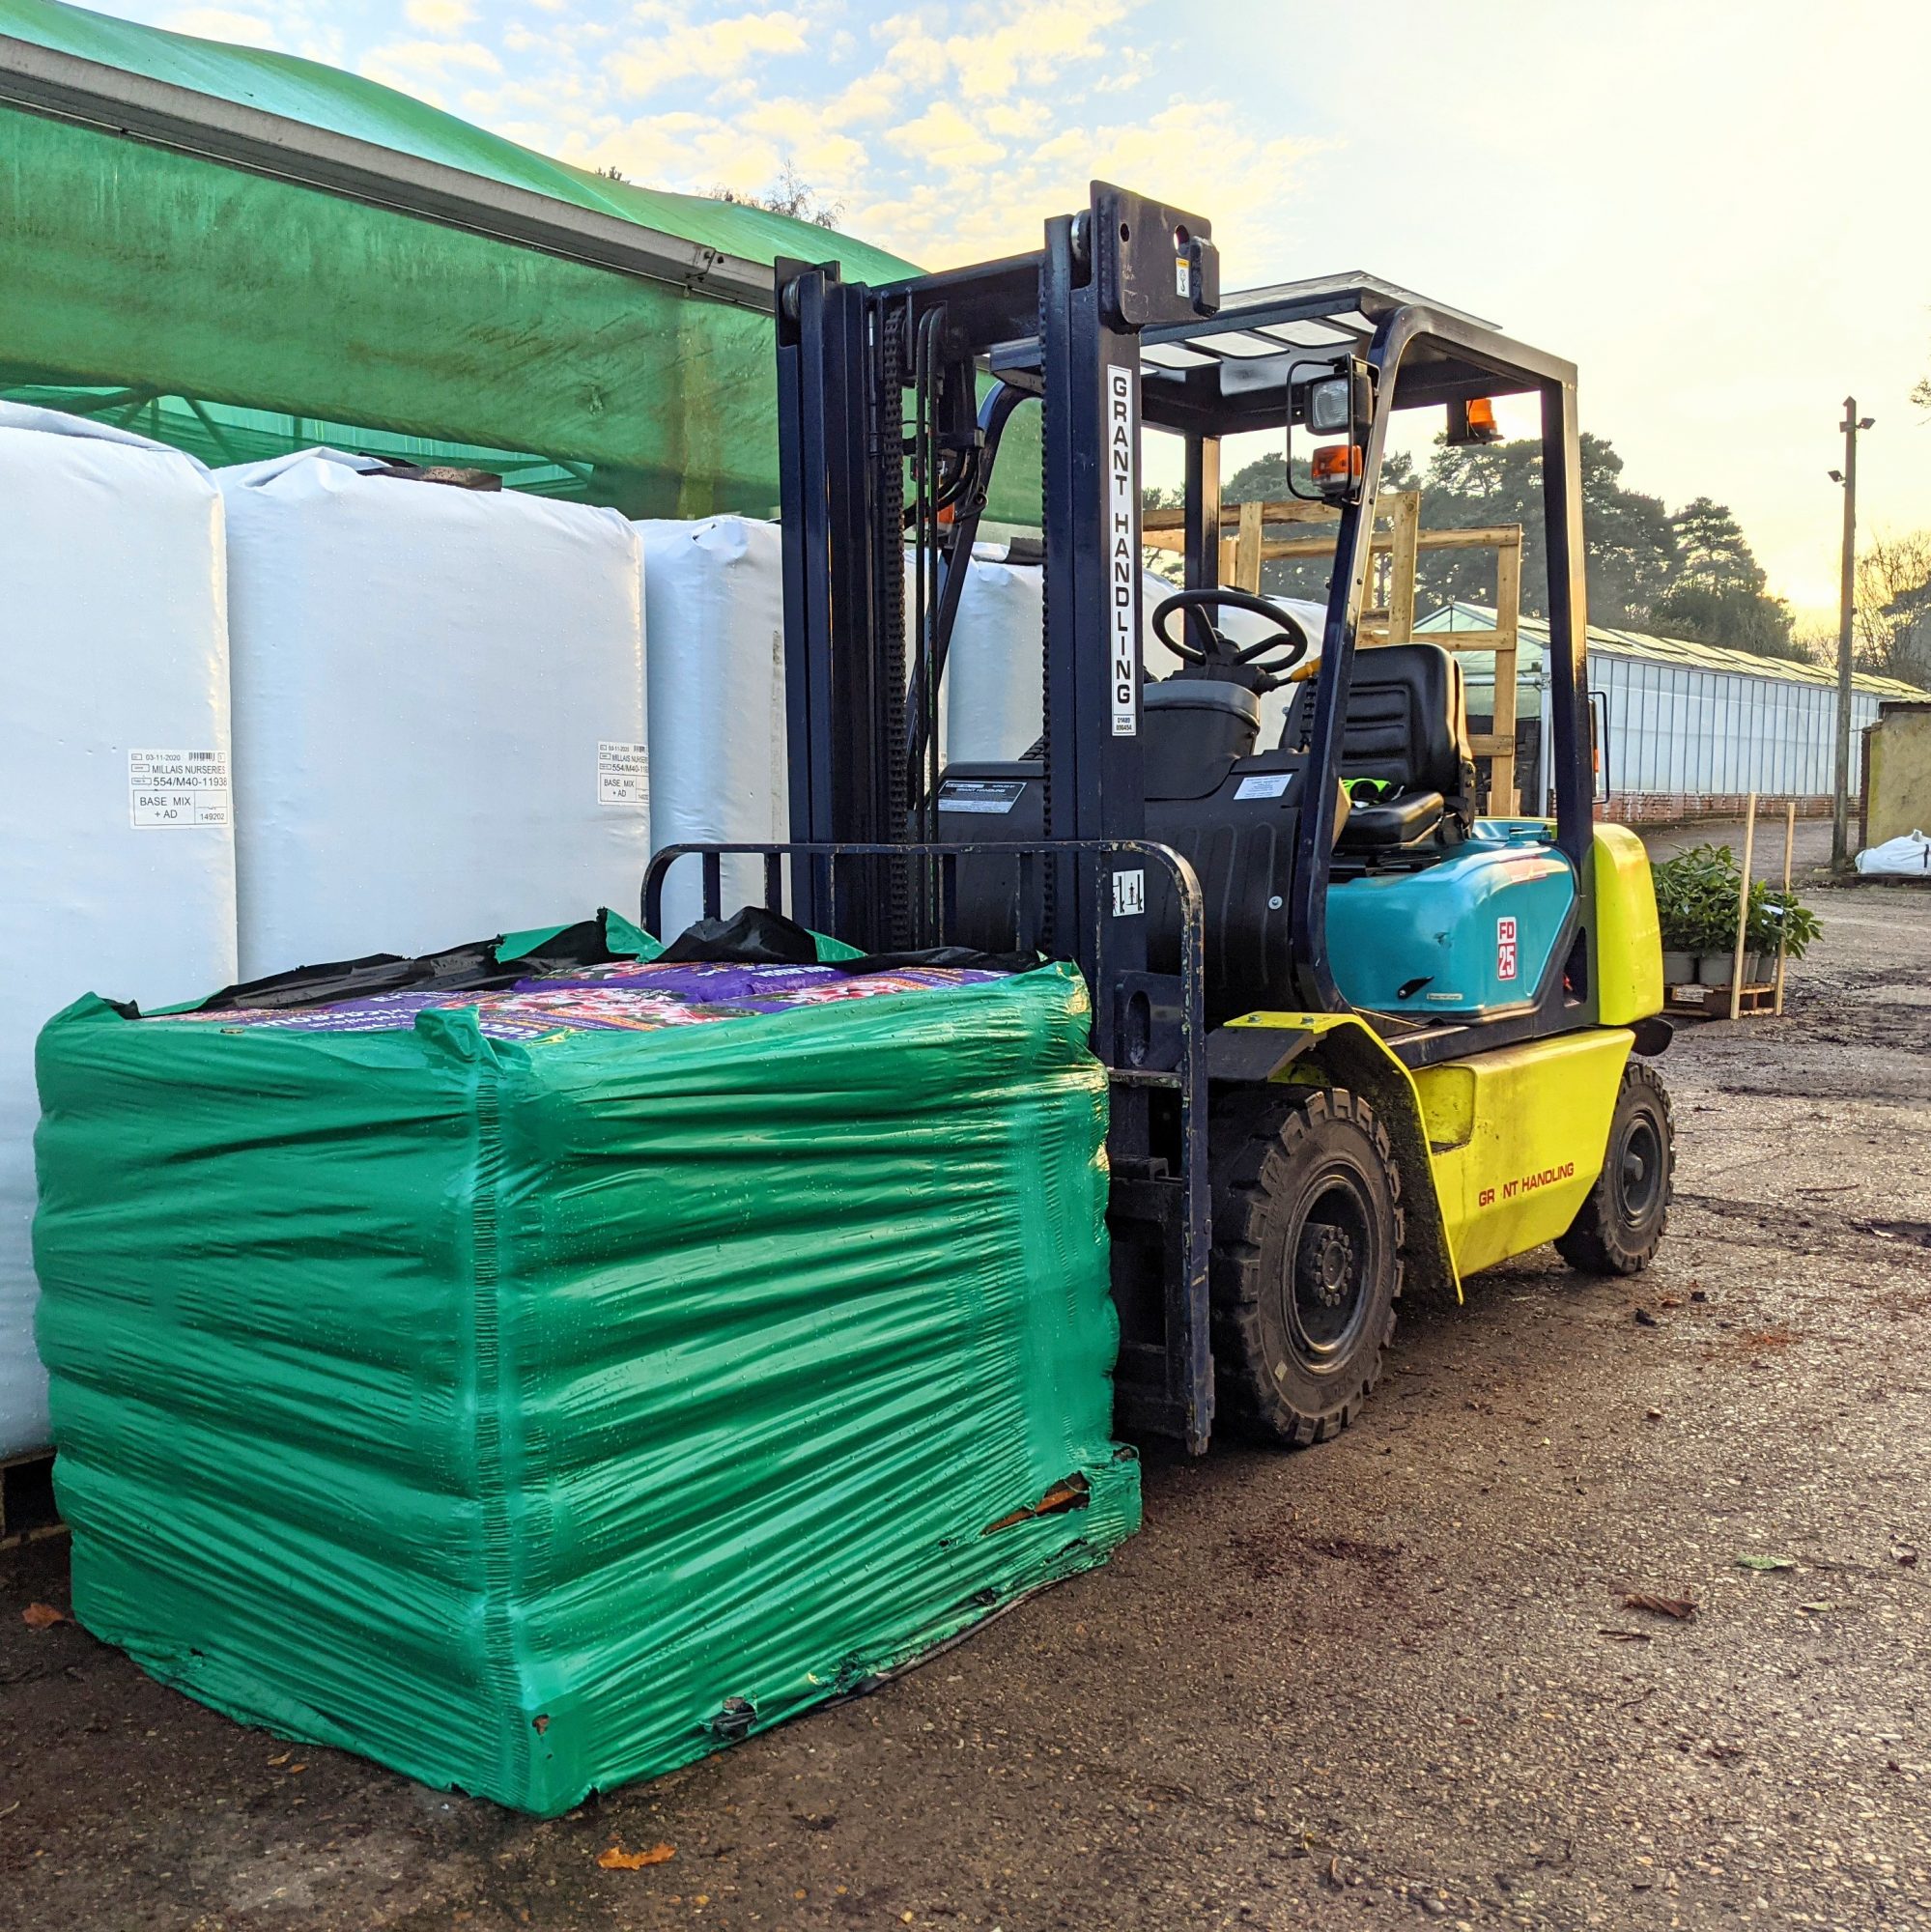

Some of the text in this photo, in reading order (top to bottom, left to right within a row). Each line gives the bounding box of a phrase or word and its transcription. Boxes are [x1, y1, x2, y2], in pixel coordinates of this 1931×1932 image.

[1113, 375, 1131, 704] GRANT HANDLING
[152, 765, 183, 774] MILLAIS
[153, 777, 227, 787] 554/M40-11938
[604, 779, 620, 787] BASE
[139, 797, 191, 807] BASE MIX
[163, 810, 178, 818] AD
[1499, 922, 1515, 940] FD
[1498, 946, 1515, 977] 25
[1478, 1162, 1574, 1208] GRNT HANDLING
